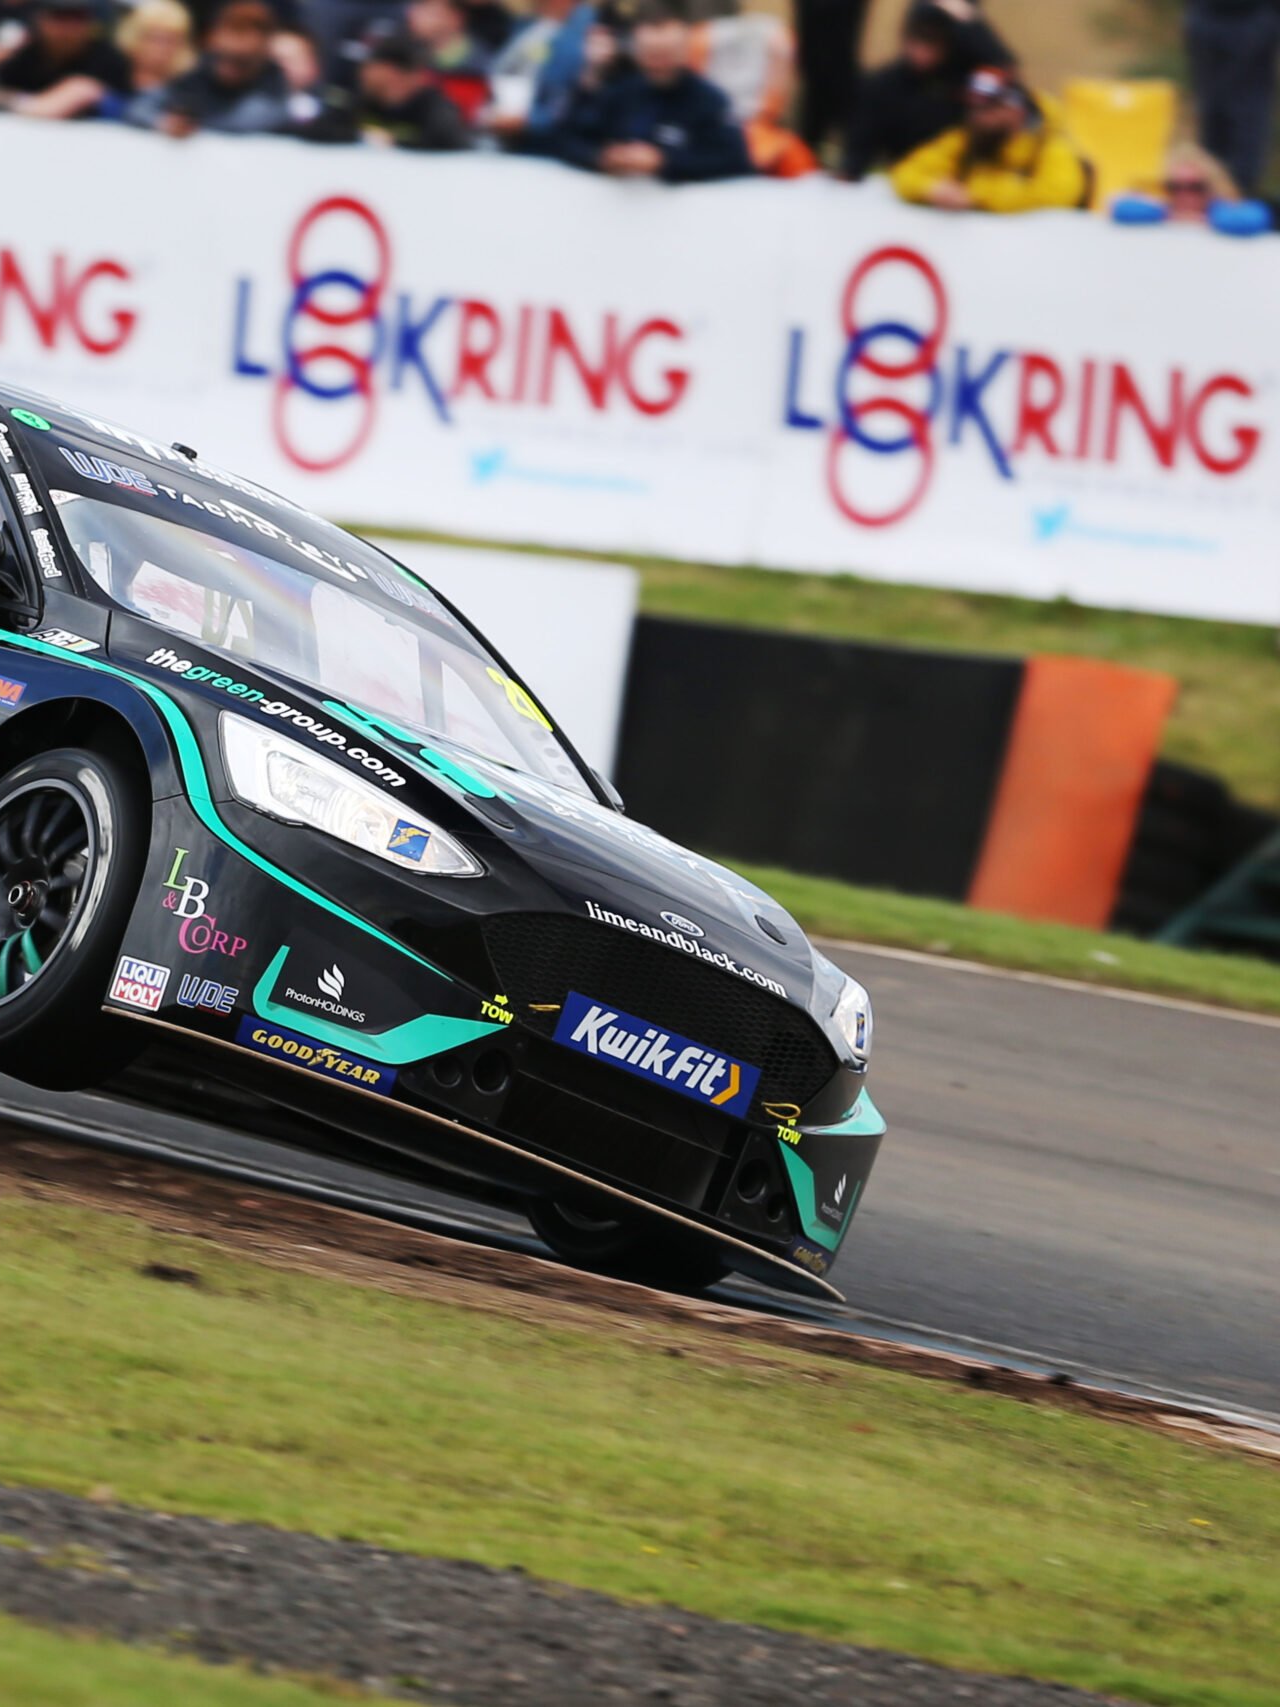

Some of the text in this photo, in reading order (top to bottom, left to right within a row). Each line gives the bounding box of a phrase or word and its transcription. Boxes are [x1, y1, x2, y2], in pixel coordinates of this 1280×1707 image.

[145, 647, 407, 788] thegreen-group.com
[585, 901, 788, 999] limeandblack.com
[121, 960, 166, 989] LIQUI
[116, 980, 163, 1008] MOLY
[176, 973, 239, 1014] WDE
[480, 1000, 514, 1025] TOW
[251, 1029, 382, 1085] GOODYEAR
[776, 1125, 802, 1145] TOW
